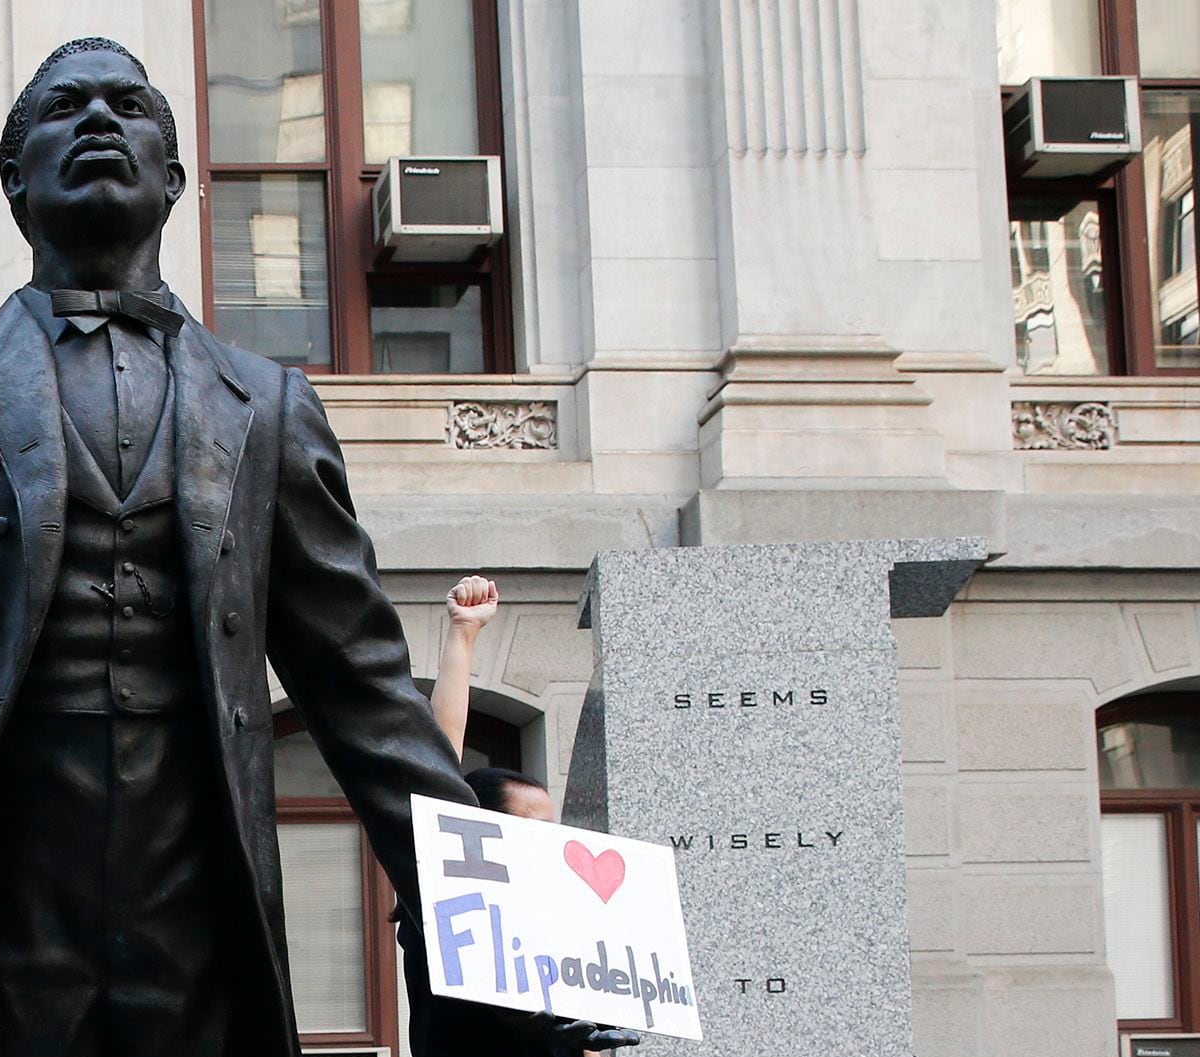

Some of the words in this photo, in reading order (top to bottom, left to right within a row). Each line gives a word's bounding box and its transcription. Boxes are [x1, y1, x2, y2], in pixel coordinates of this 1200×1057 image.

[673, 688, 829, 709] SEEMS
[437, 813, 510, 883] I
[669, 831, 844, 850] WISELY
[433, 892, 693, 1028] Flipadelphia
[734, 977, 787, 994] TO
